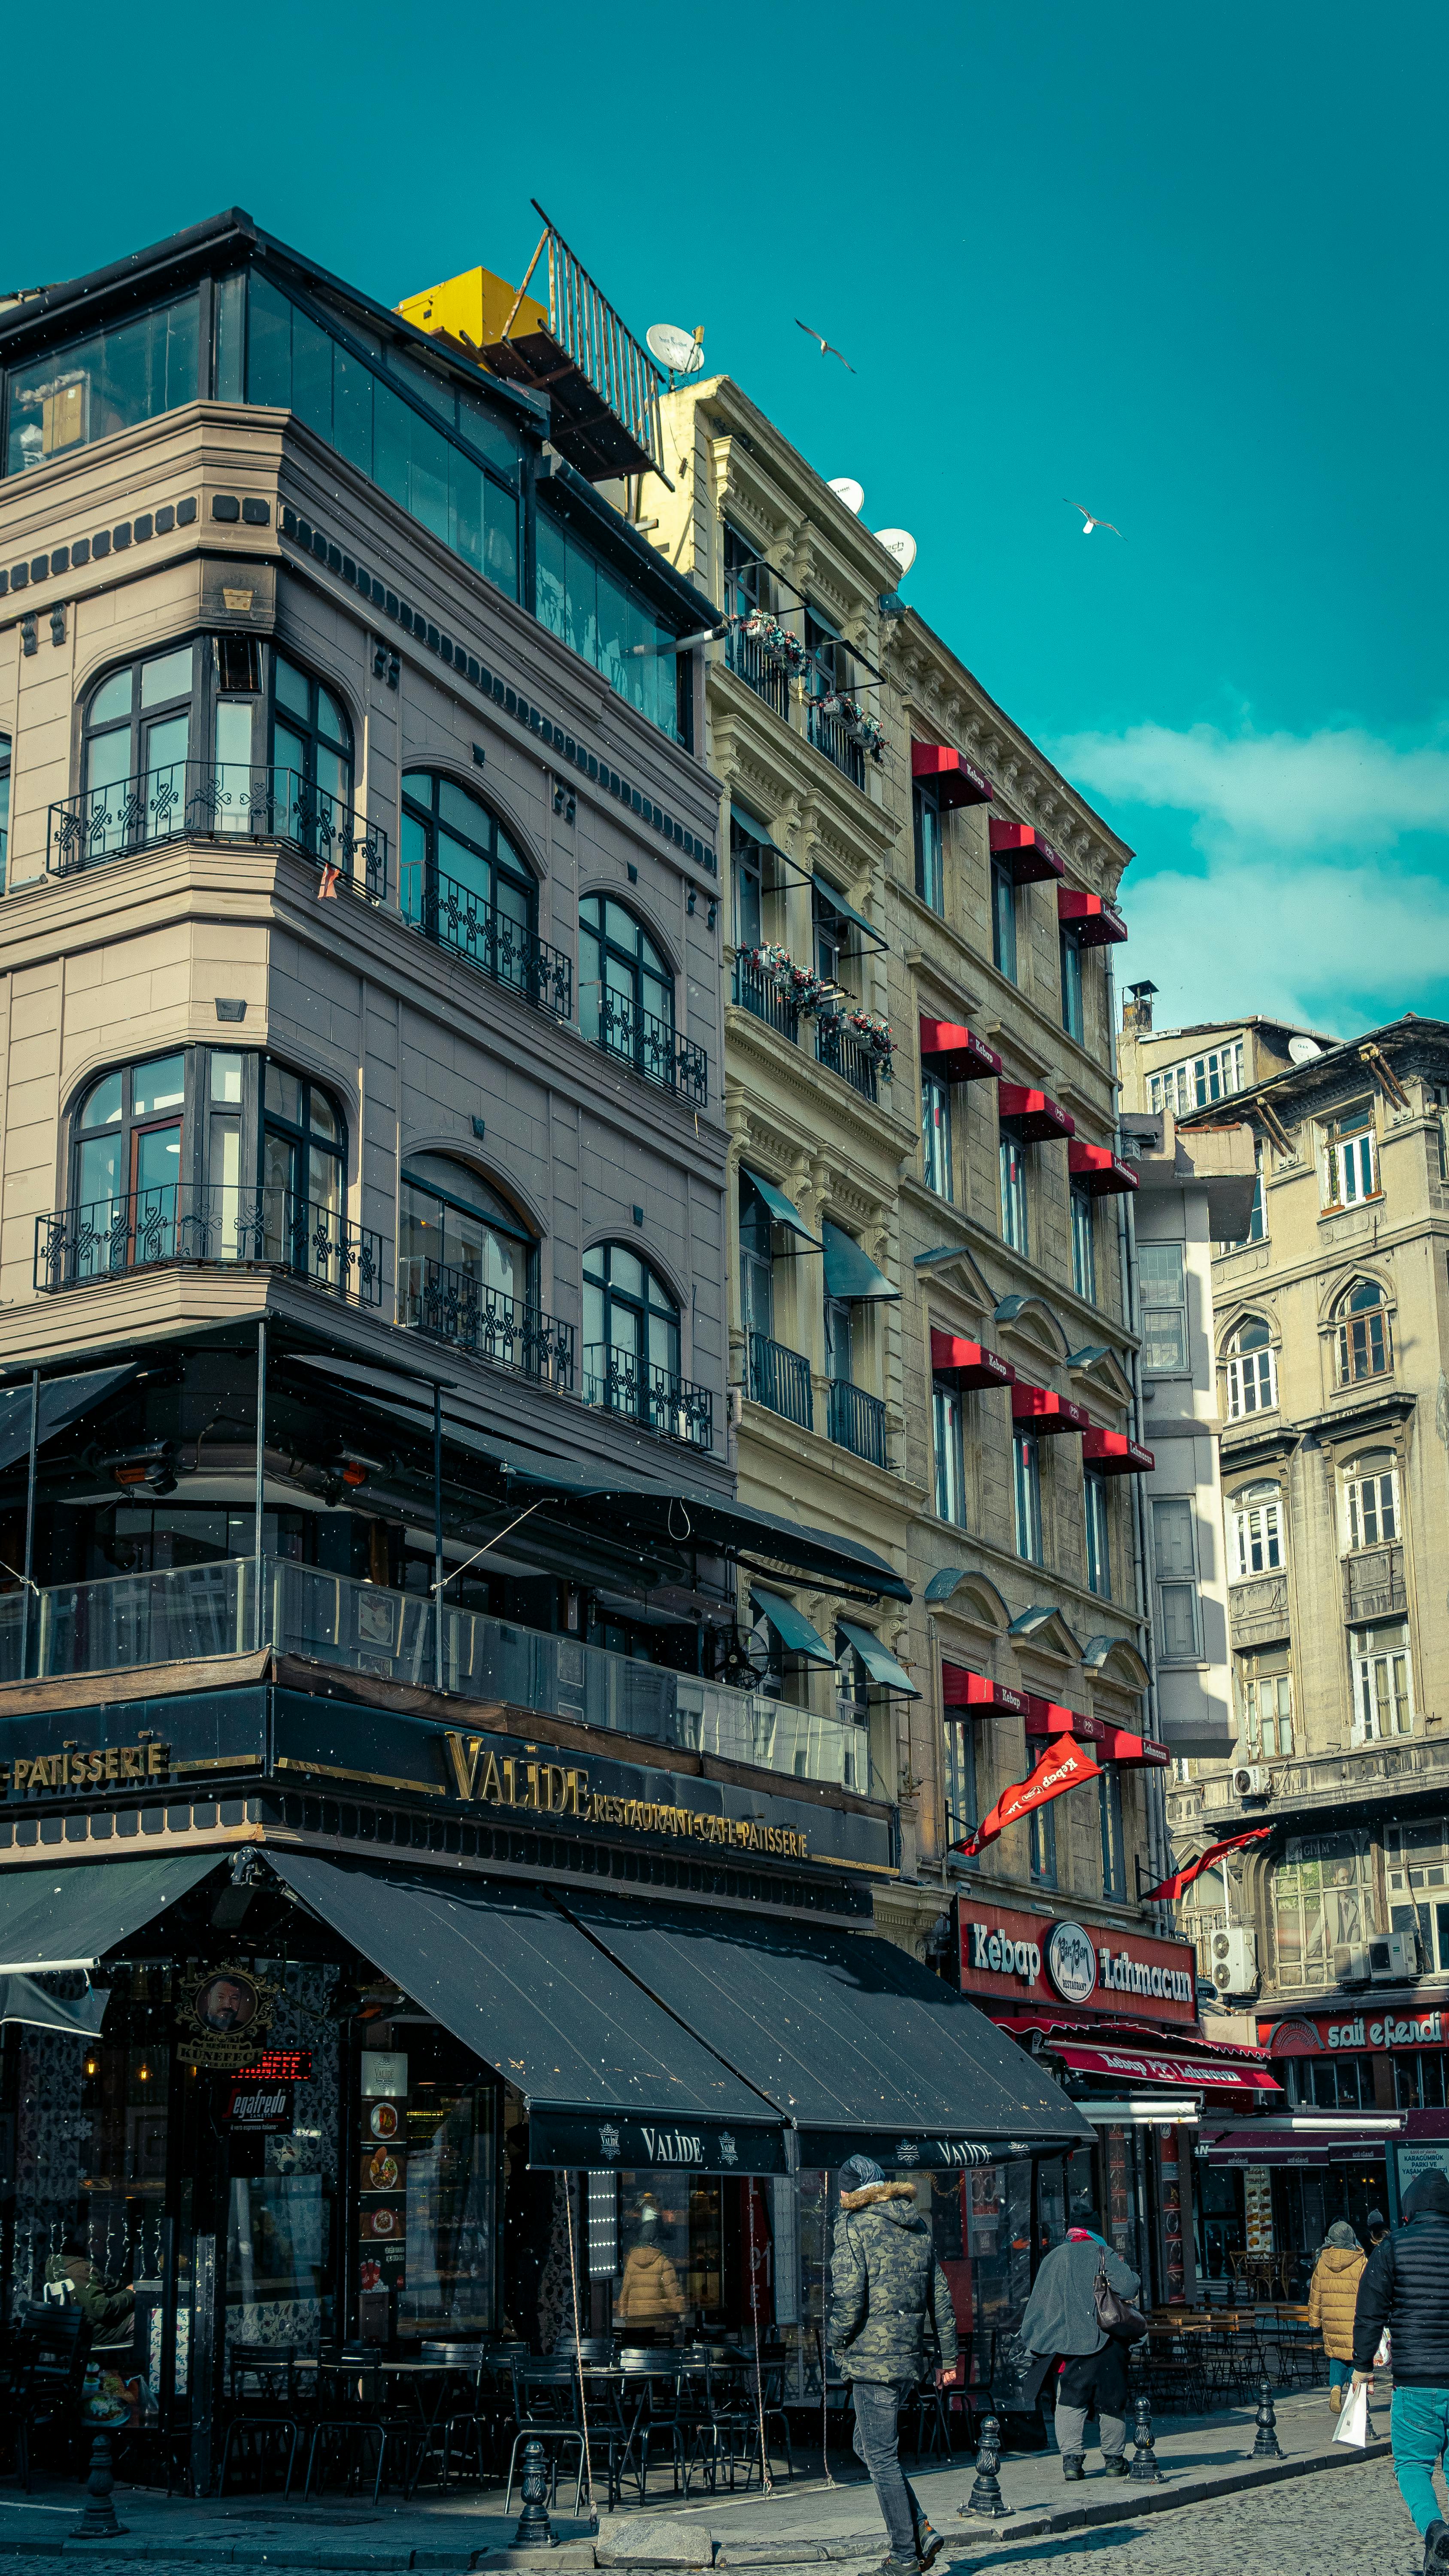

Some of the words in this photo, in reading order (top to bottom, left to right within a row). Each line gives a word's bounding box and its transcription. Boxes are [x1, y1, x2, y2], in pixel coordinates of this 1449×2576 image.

[967, 763, 984, 789] Kebap
[976, 1039, 993, 1063] Kebap
[1114, 1157, 1137, 1184] Lahmacun
[988, 1354, 1006, 1376] Kebap
[1130, 1442, 1152, 1465] Lahmacun
[1002, 1688, 1020, 1710] Kebap
[1143, 1742, 1167, 1761] Lahmacun
[1042, 1757, 1079, 1788] Kebap
[973, 1923, 1041, 1986] Kebap
[1062, 1979, 1087, 1992] RESTAURANT
[1104, 1948, 1193, 2002] Lahmacun
[1328, 2017, 1365, 2047] sait
[1370, 2011, 1442, 2048] efendi
[1097, 2053, 1147, 2076] Kebap
[1173, 2062, 1242, 2081] Lahmacun
[221, 2088, 286, 2118] Segafredo
[640, 2128, 703, 2163] VALİDE
[936, 2141, 992, 2166] VALİDE
